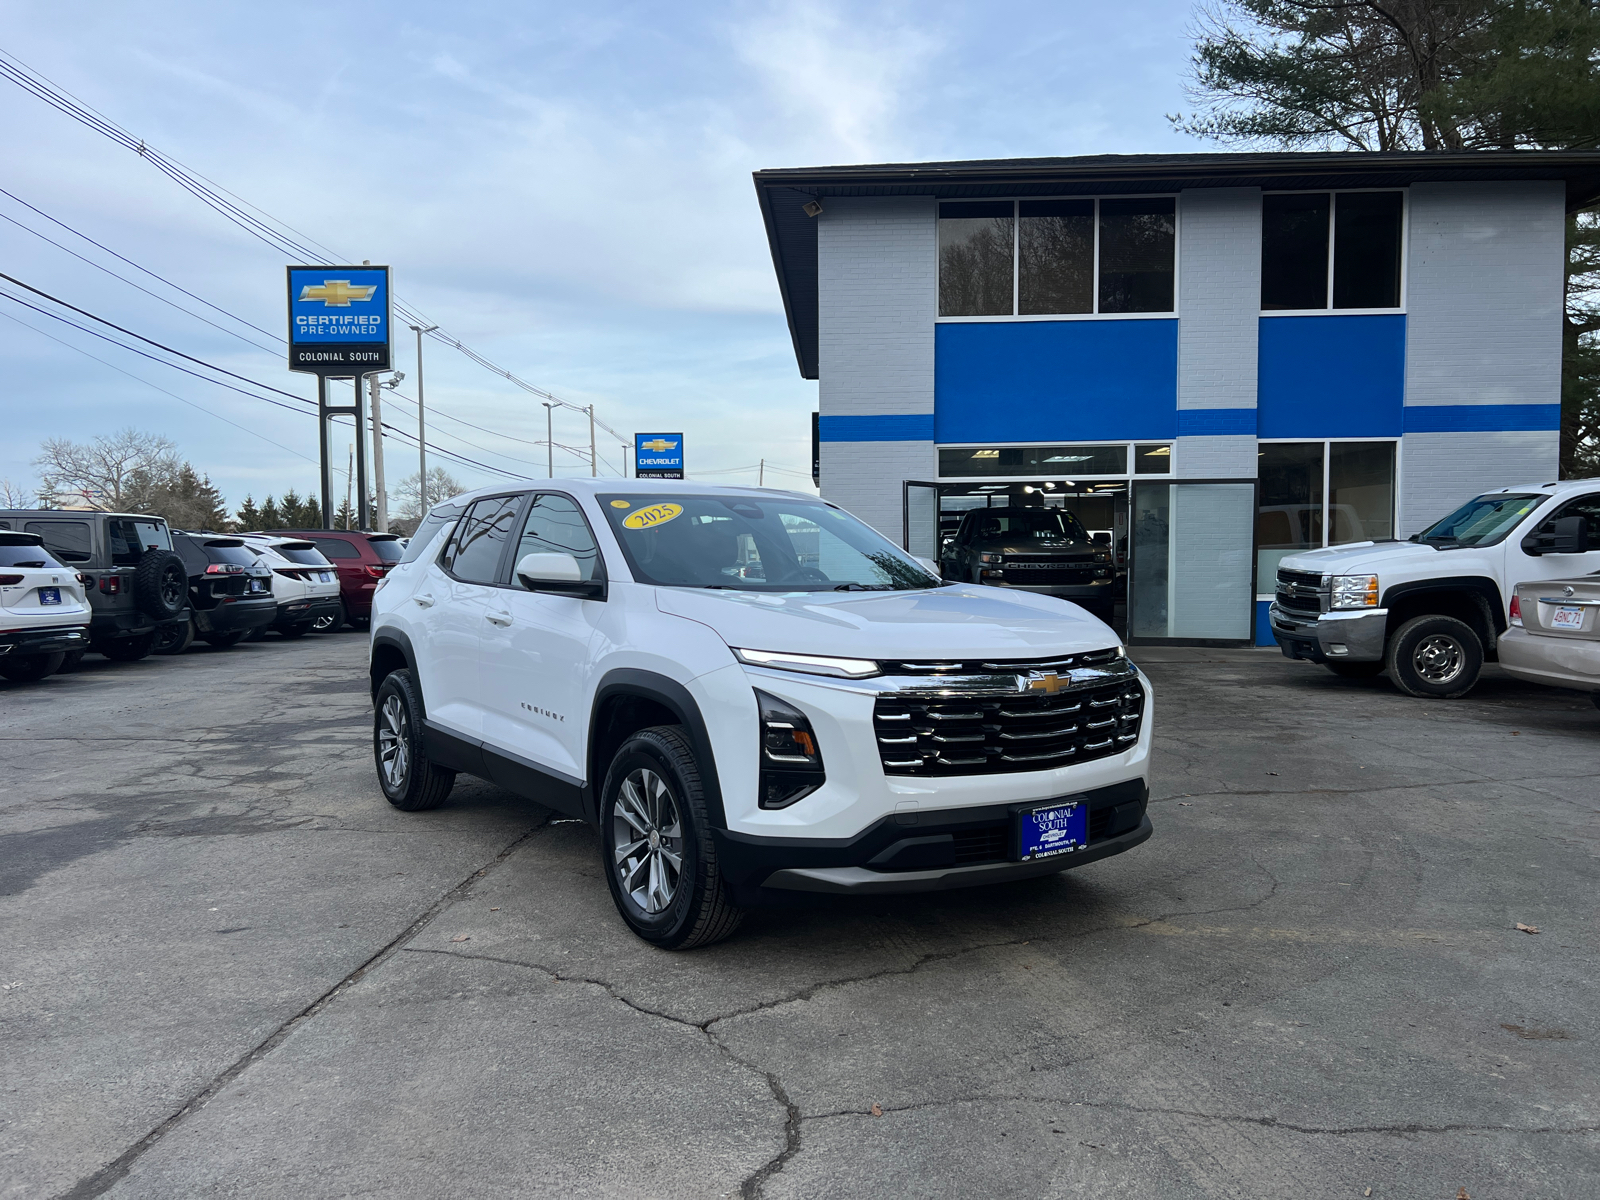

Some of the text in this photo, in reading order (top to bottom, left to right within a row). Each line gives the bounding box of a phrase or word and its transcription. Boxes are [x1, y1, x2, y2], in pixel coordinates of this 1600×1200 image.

[296, 315, 381, 325] CERTIFIED
[300, 325, 377, 334] PRE-OWNED
[299, 352, 379, 361] COLONIAL SOUTH
[634, 504, 675, 526] 2025
[1033, 808, 1074, 823] COLONIAL
[1039, 818, 1067, 832] SOUTH
[1035, 849, 1058, 858] COLONIAL
